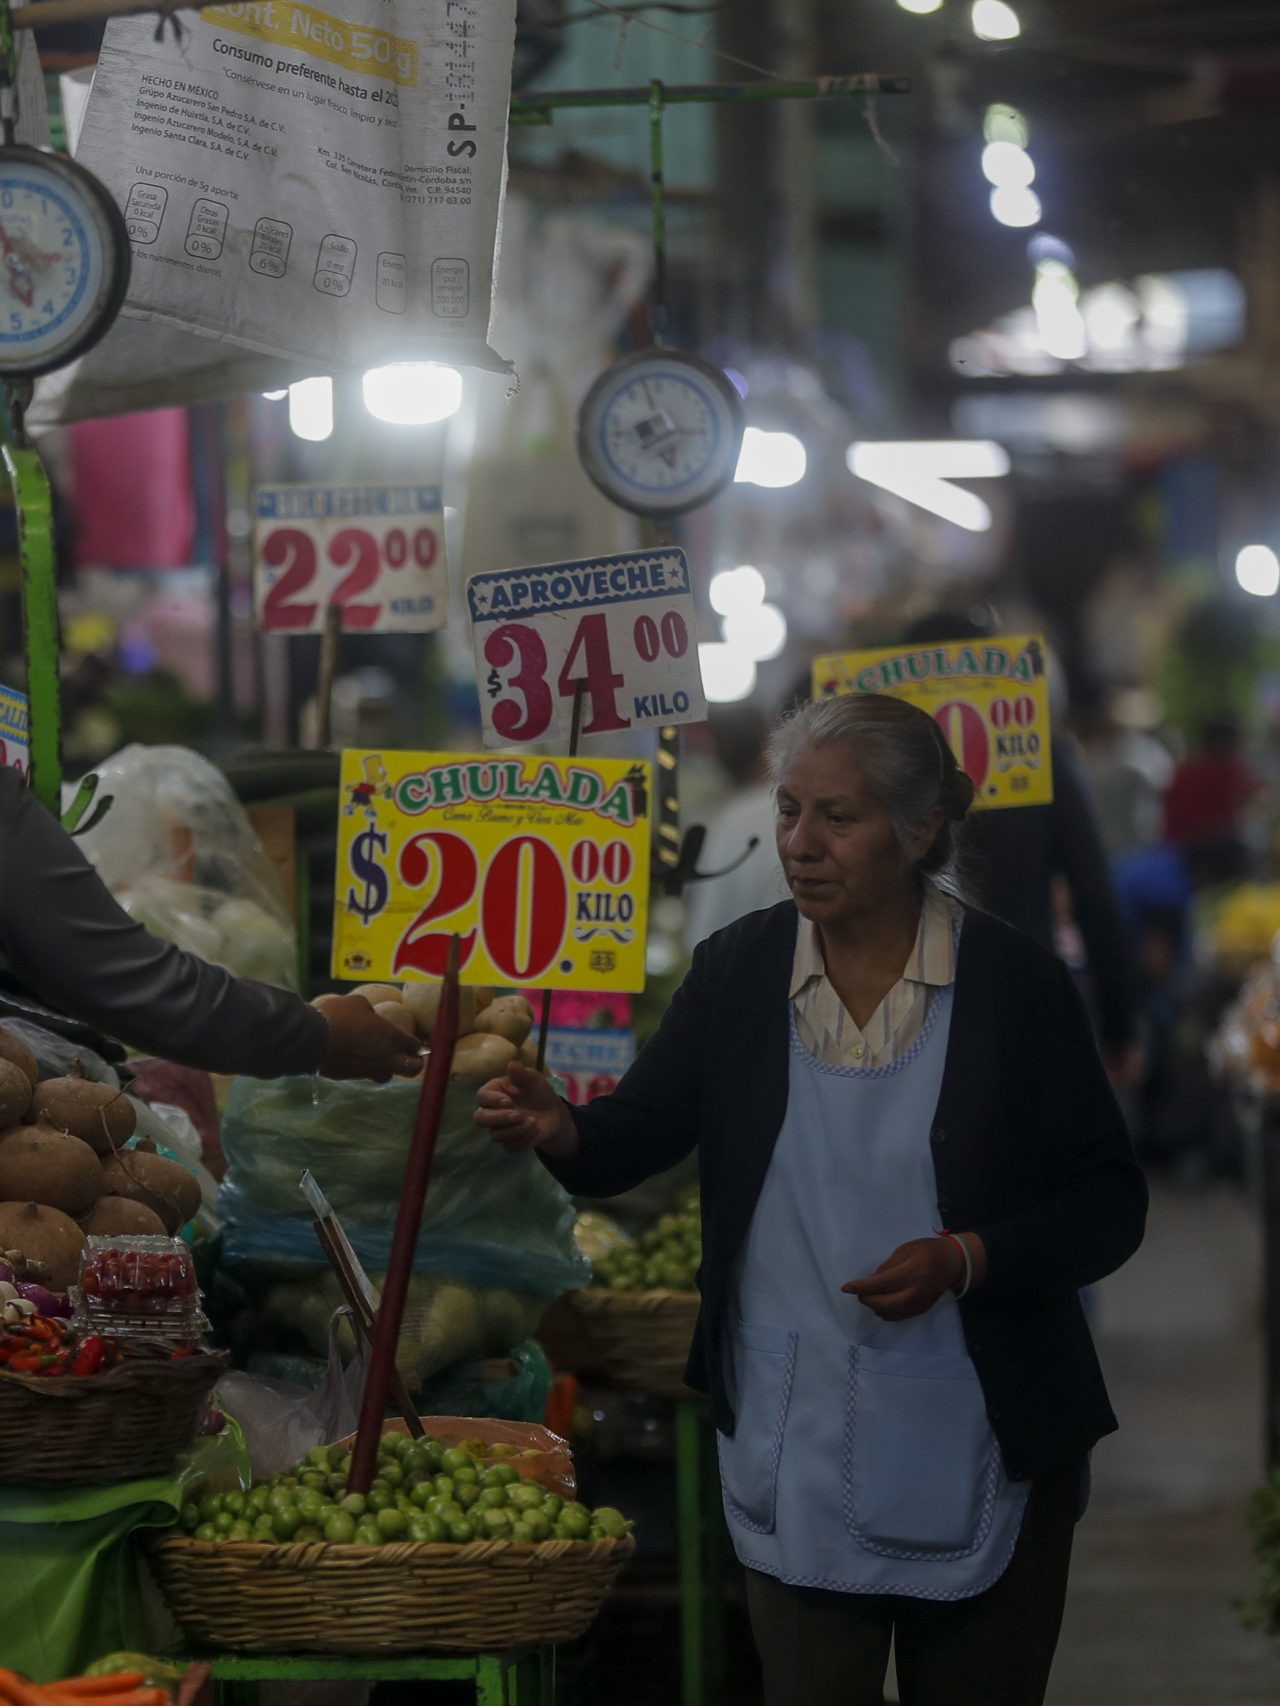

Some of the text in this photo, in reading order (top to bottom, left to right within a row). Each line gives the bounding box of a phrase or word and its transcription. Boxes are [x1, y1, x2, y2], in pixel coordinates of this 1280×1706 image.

[291, 9, 345, 51] Neto
[351, 31, 391, 64] 50
[212, 38, 383, 103] Consumo preferente hasta el
[142, 74, 220, 101] HECHO EN MÉXICO
[278, 84, 290, 96] en
[292, 88, 305, 100] un
[136, 98, 167, 113] Ingenio
[168, 104, 180, 116] de
[226, 120, 237, 131] de
[139, 86, 165, 100] Grupo
[166, 92, 207, 109] Azucarero
[207, 101, 220, 112] San
[221, 105, 243, 121] Pedro
[258, 117, 270, 129] de
[131, 122, 162, 138] Ingenio
[164, 129, 186, 143] Santa
[188, 135, 209, 150] Clara,
[225, 146, 236, 157] de
[134, 110, 165, 127] Ingenio
[166, 117, 206, 135] Azucarero
[252, 142, 263, 153] de
[135, 164, 153, 177] Una
[154, 170, 187, 186] porción
[188, 177, 199, 189] de
[325, 160, 339, 172] Col.
[404, 164, 444, 175] Domicilio
[2, 190, 13, 208] 0
[137, 189, 158, 201] Grasa
[62, 228, 74, 246] 2
[10, 312, 23, 332] 5
[42, 301, 55, 316] 4
[384, 526, 439, 571] 00
[489, 563, 667, 610] APROVECHE
[632, 610, 689, 663] 00
[856, 650, 1036, 694] CHULADA
[632, 690, 690, 720] KILO
[996, 733, 1041, 757] KILO
[394, 760, 637, 827] CHULADA
[570, 839, 633, 885] 00
[575, 892, 634, 923] KILO
